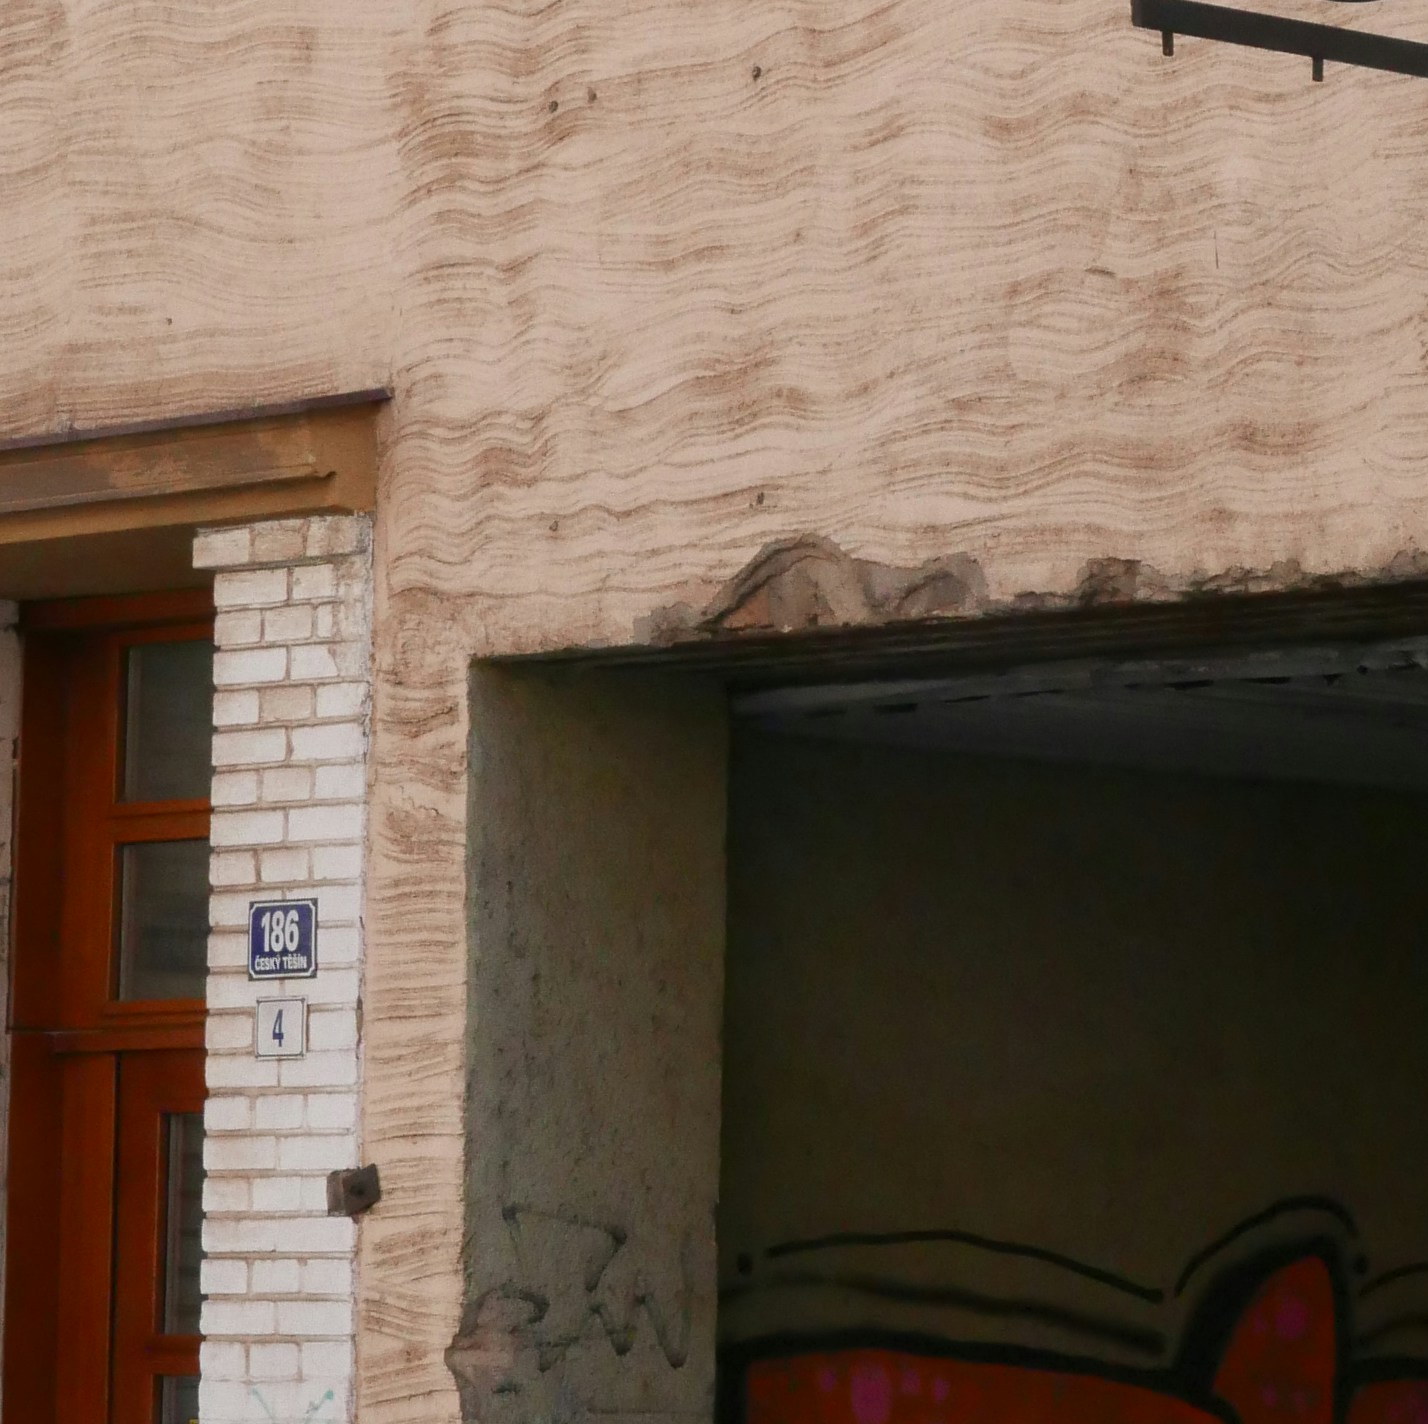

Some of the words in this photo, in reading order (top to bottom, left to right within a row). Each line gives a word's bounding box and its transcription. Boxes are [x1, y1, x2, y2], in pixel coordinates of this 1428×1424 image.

[261, 910, 299, 952] 186
[255, 954, 281, 971] ČESKÝ
[283, 954, 307, 970] TĚŠÍN
[272, 1009, 284, 1047] 4
